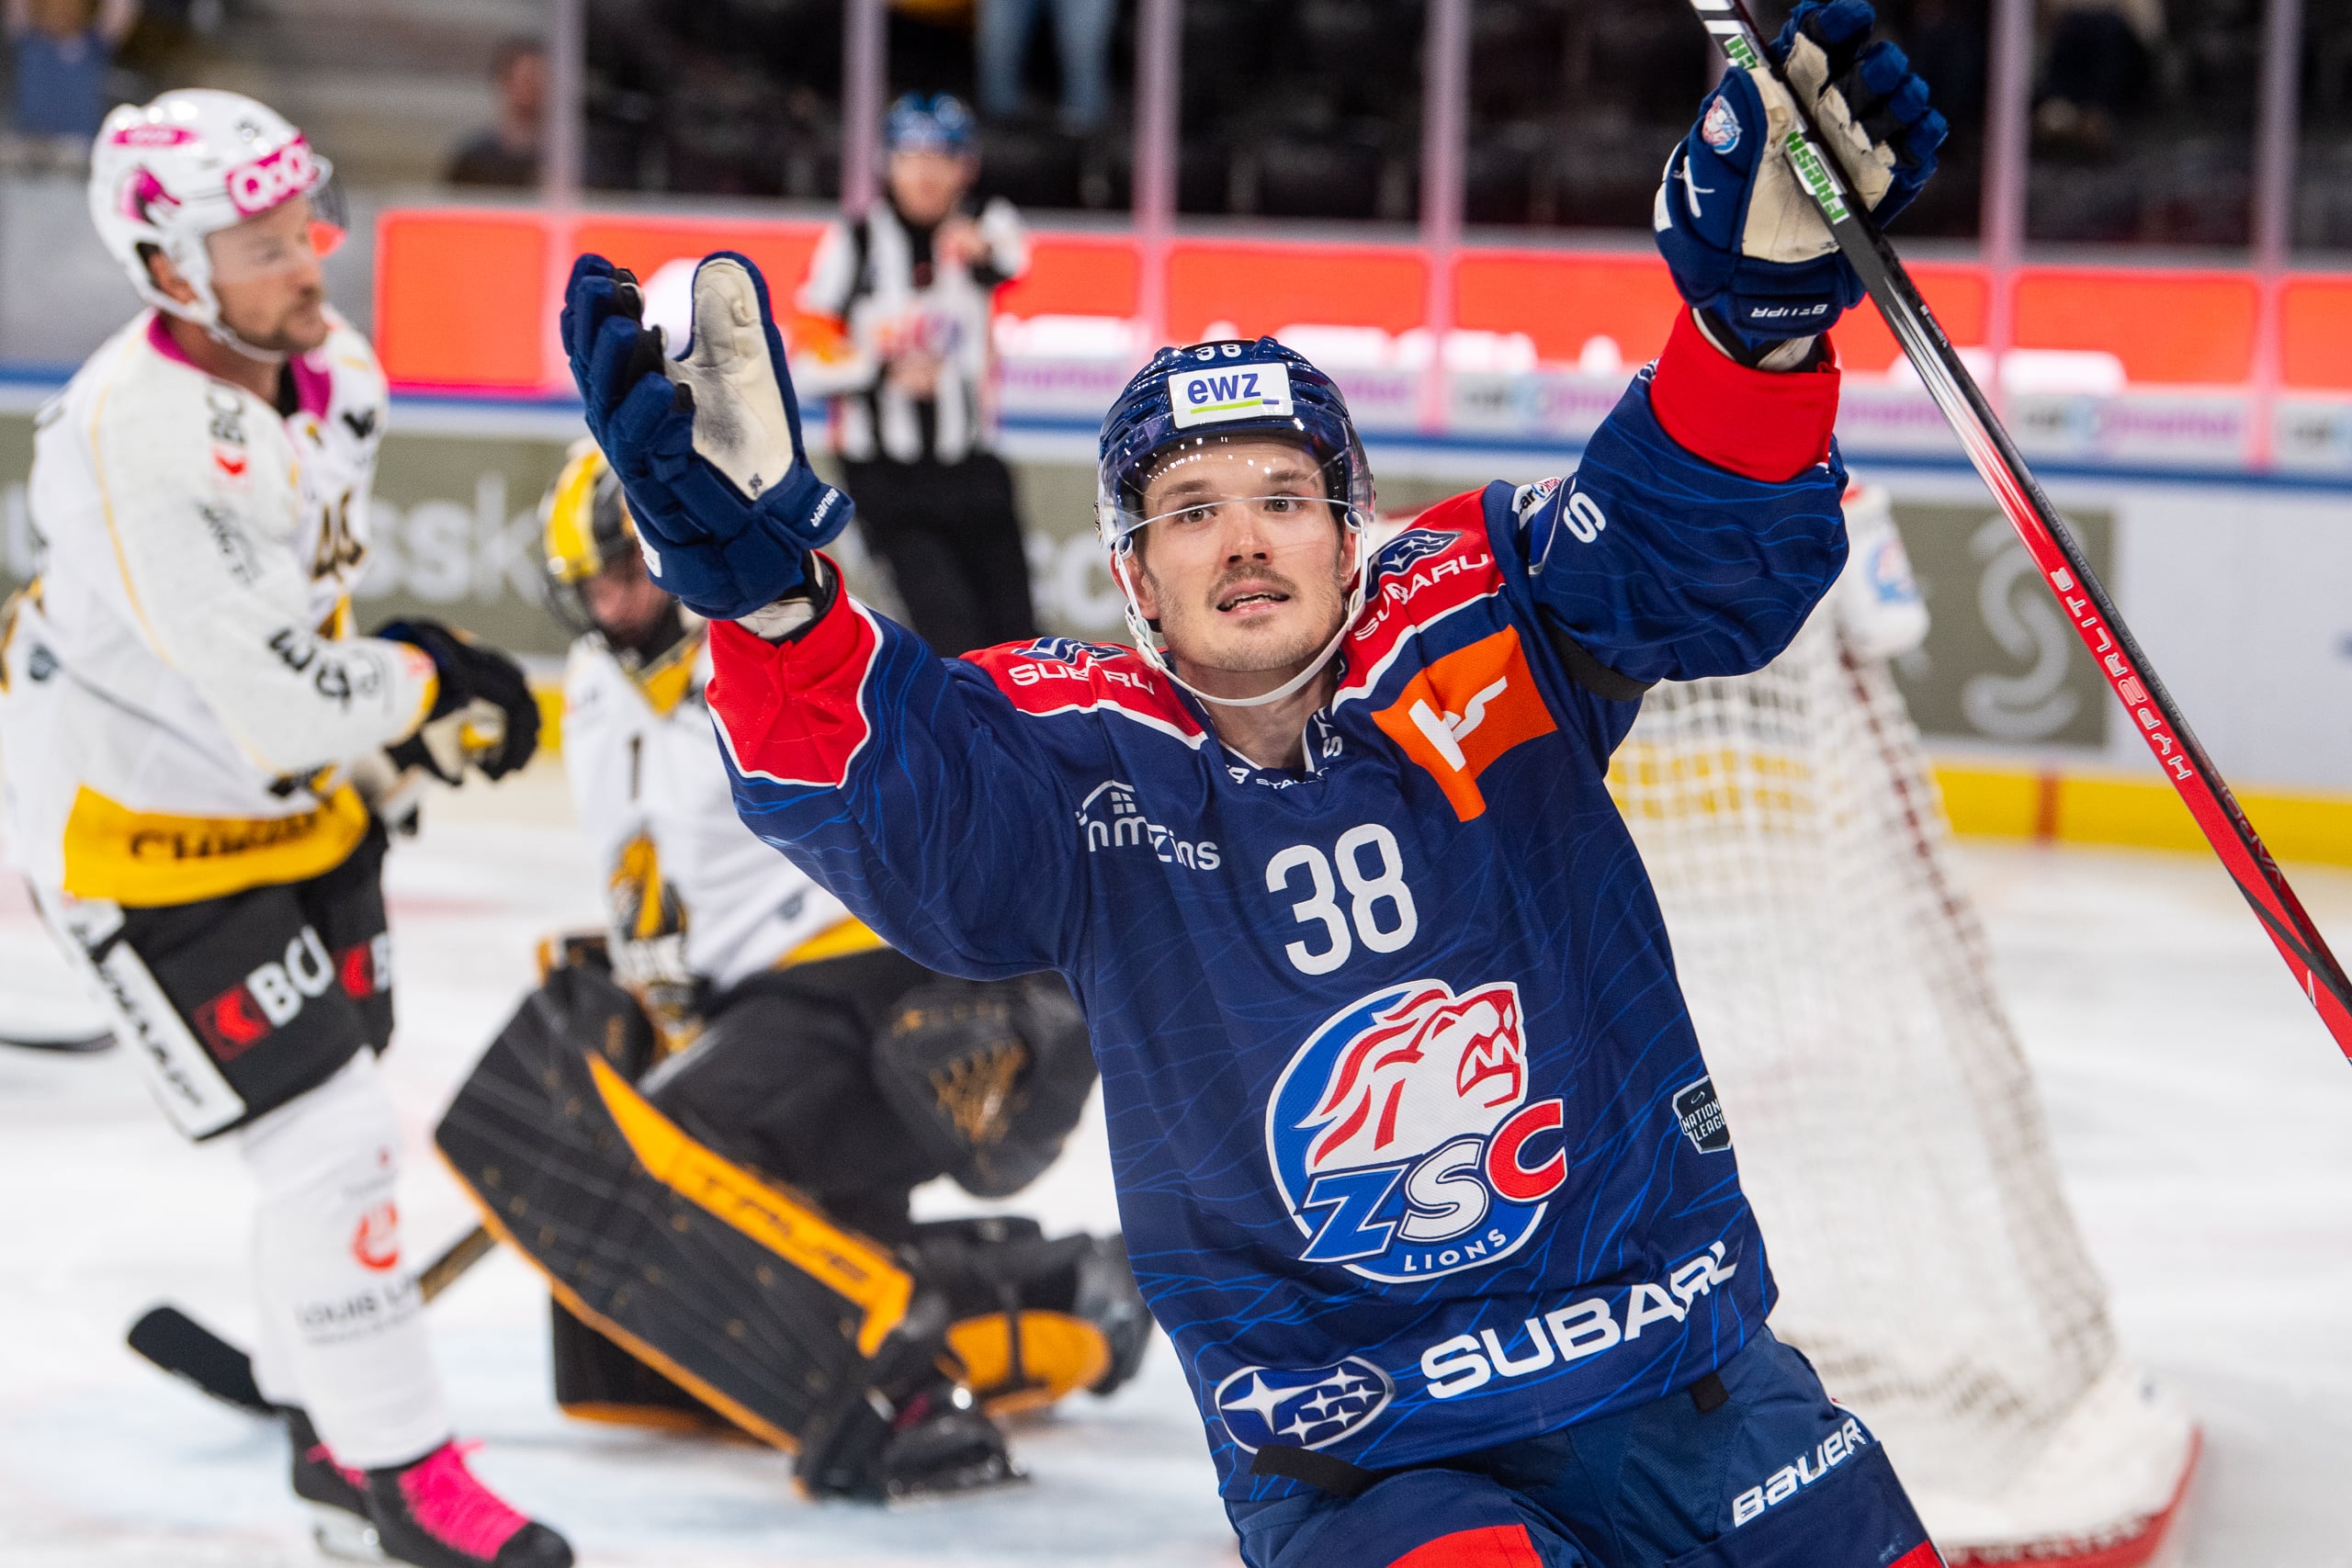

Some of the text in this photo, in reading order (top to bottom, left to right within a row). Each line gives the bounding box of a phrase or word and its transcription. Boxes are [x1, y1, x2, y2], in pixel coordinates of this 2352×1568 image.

[1187, 373, 1261, 404] ewz
[1354, 553, 1489, 641] SUBARU
[1265, 823, 1419, 976] 38
[1298, 1098, 1567, 1263] ZSC
[1404, 1228, 1508, 1272] LIONS
